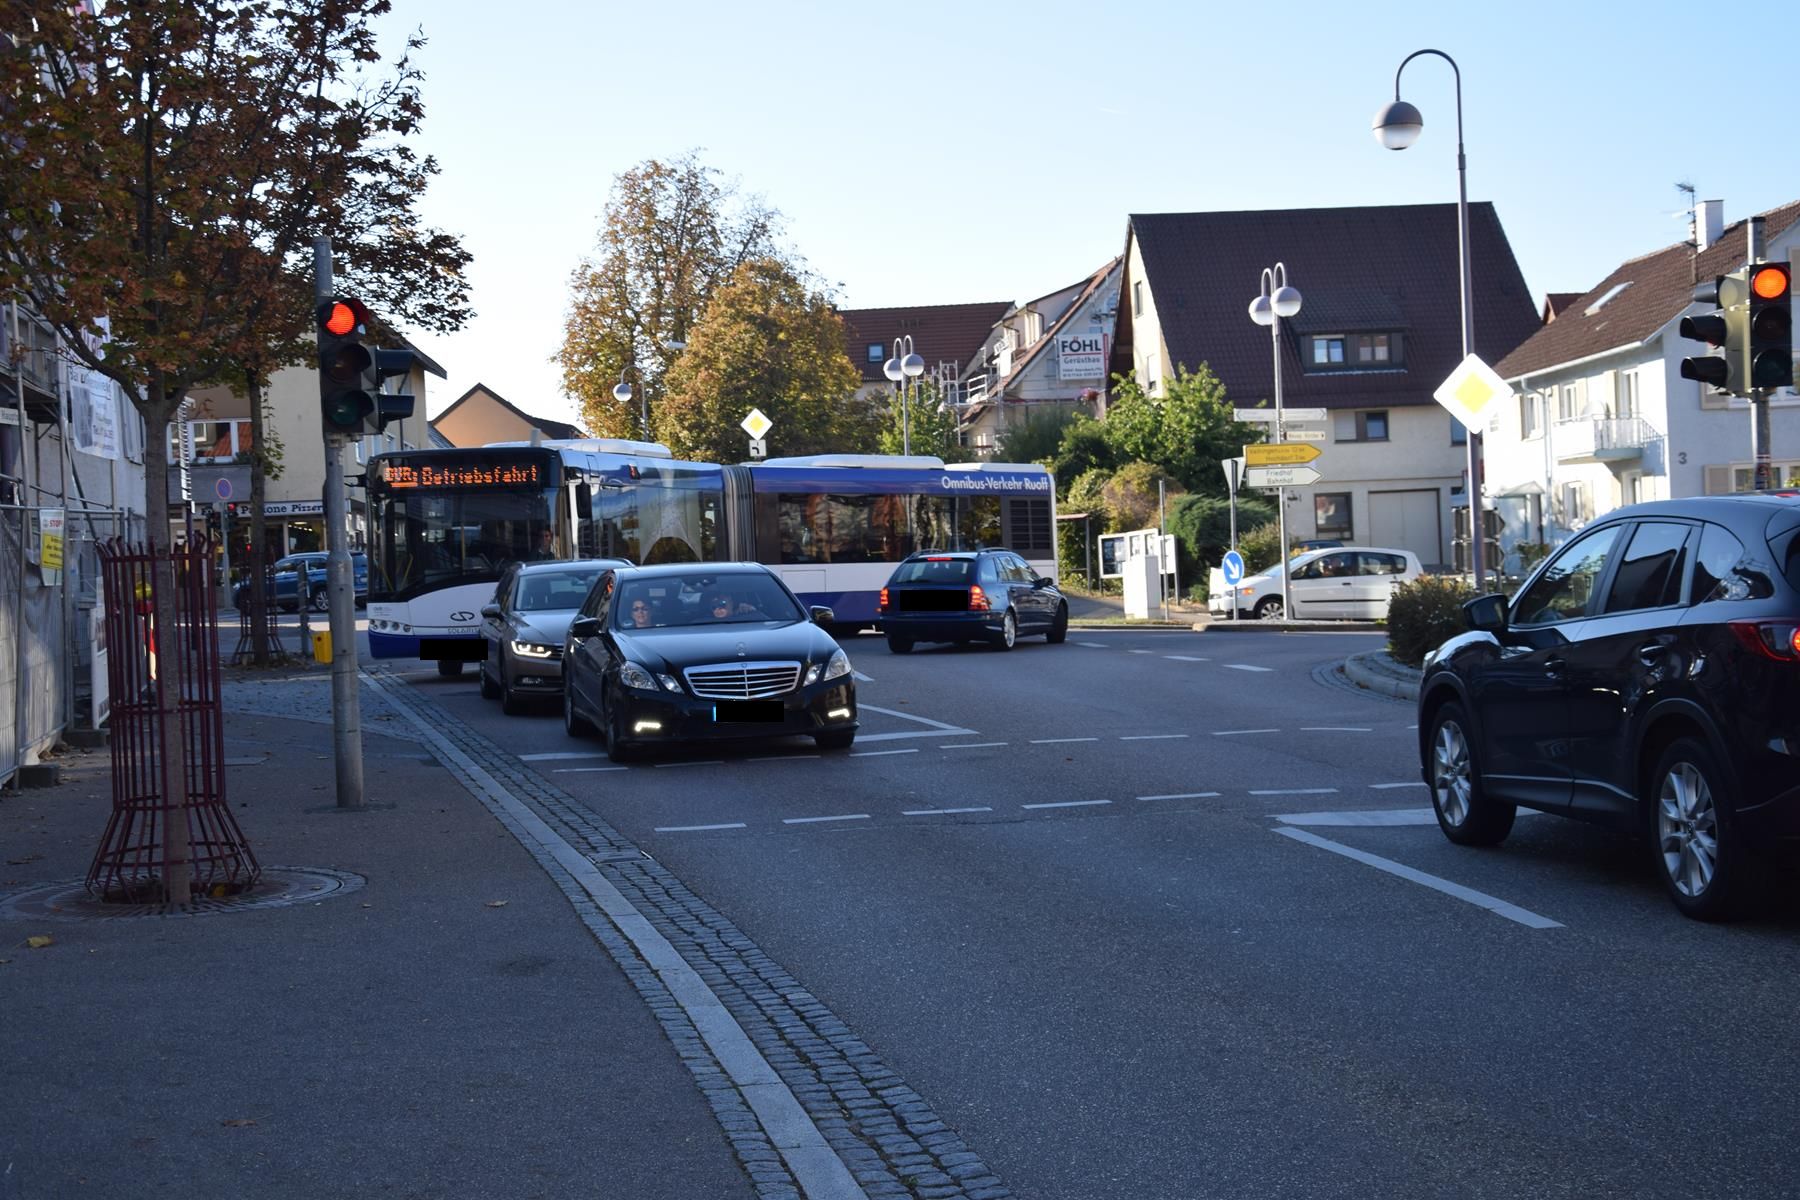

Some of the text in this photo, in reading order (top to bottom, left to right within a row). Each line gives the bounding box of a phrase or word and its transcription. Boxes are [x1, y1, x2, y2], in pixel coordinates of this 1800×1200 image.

[1061, 336, 1102, 352] FÖHL
[1063, 356, 1101, 364] Gerüstbau
[1679, 451, 1687, 465] 3
[422, 465, 537, 485] Betriebsfahrt
[941, 475, 1048, 490] Omnibus-Verkehr Ruoff
